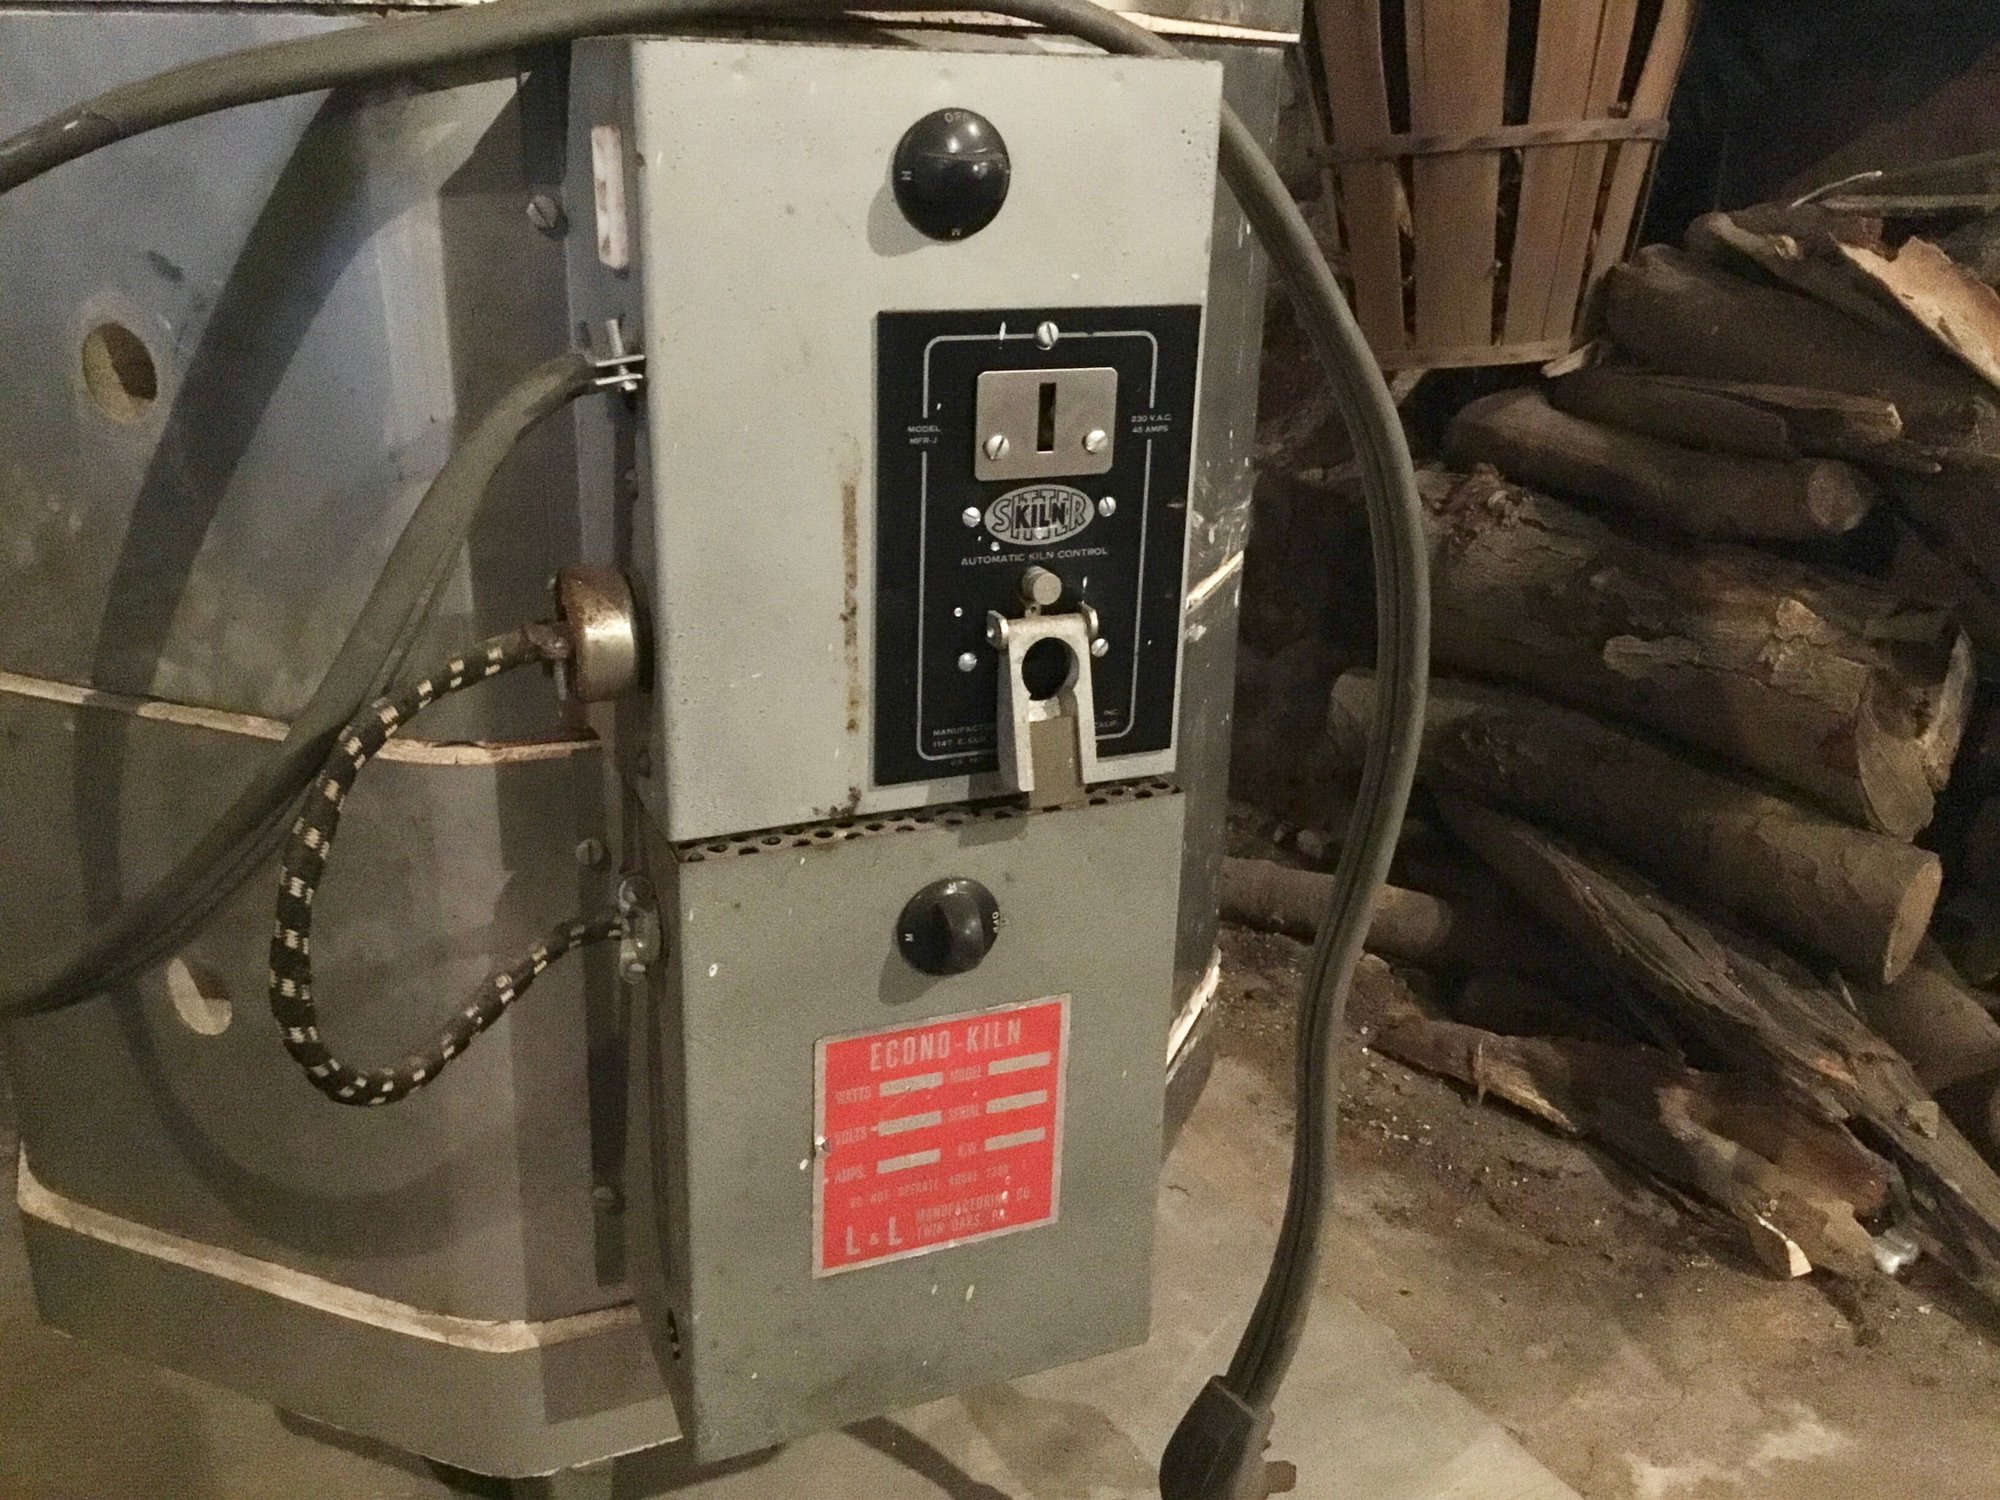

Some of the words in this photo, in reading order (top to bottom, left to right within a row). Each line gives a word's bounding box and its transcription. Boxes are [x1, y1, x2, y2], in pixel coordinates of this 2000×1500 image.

[907, 425, 940, 433] MODEL
[1015, 502, 1067, 529] KILN
[960, 553, 1025, 566] AUTOMATIC
[1029, 552, 1055, 560] KILN
[1057, 547, 1109, 559] CONTROL
